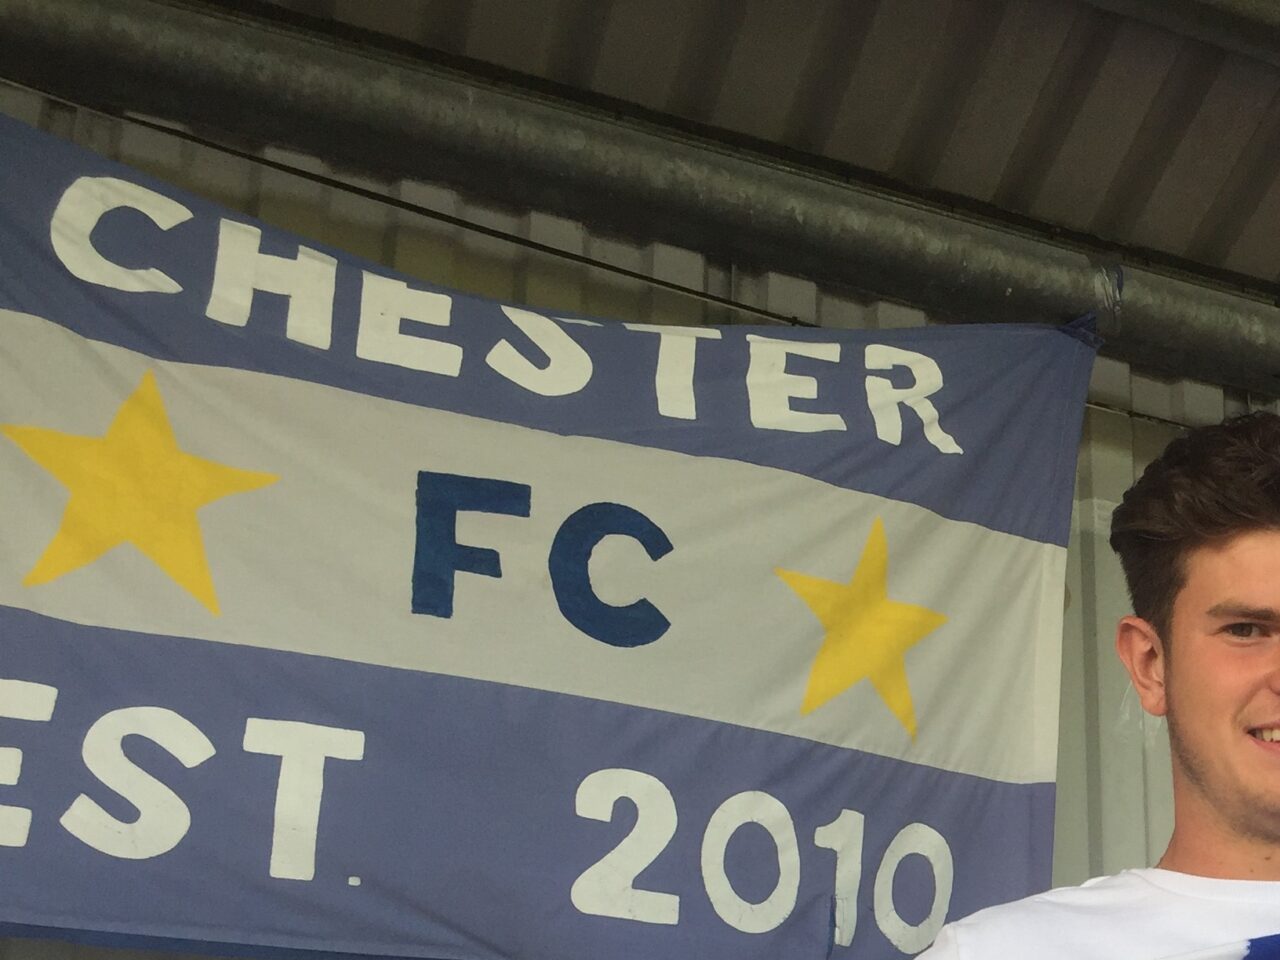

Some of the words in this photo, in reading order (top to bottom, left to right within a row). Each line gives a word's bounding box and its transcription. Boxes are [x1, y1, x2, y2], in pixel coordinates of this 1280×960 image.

[50, 176, 964, 455] CHESTER
[411, 470, 674, 648] FC
[570, 768, 954, 955] 2010
